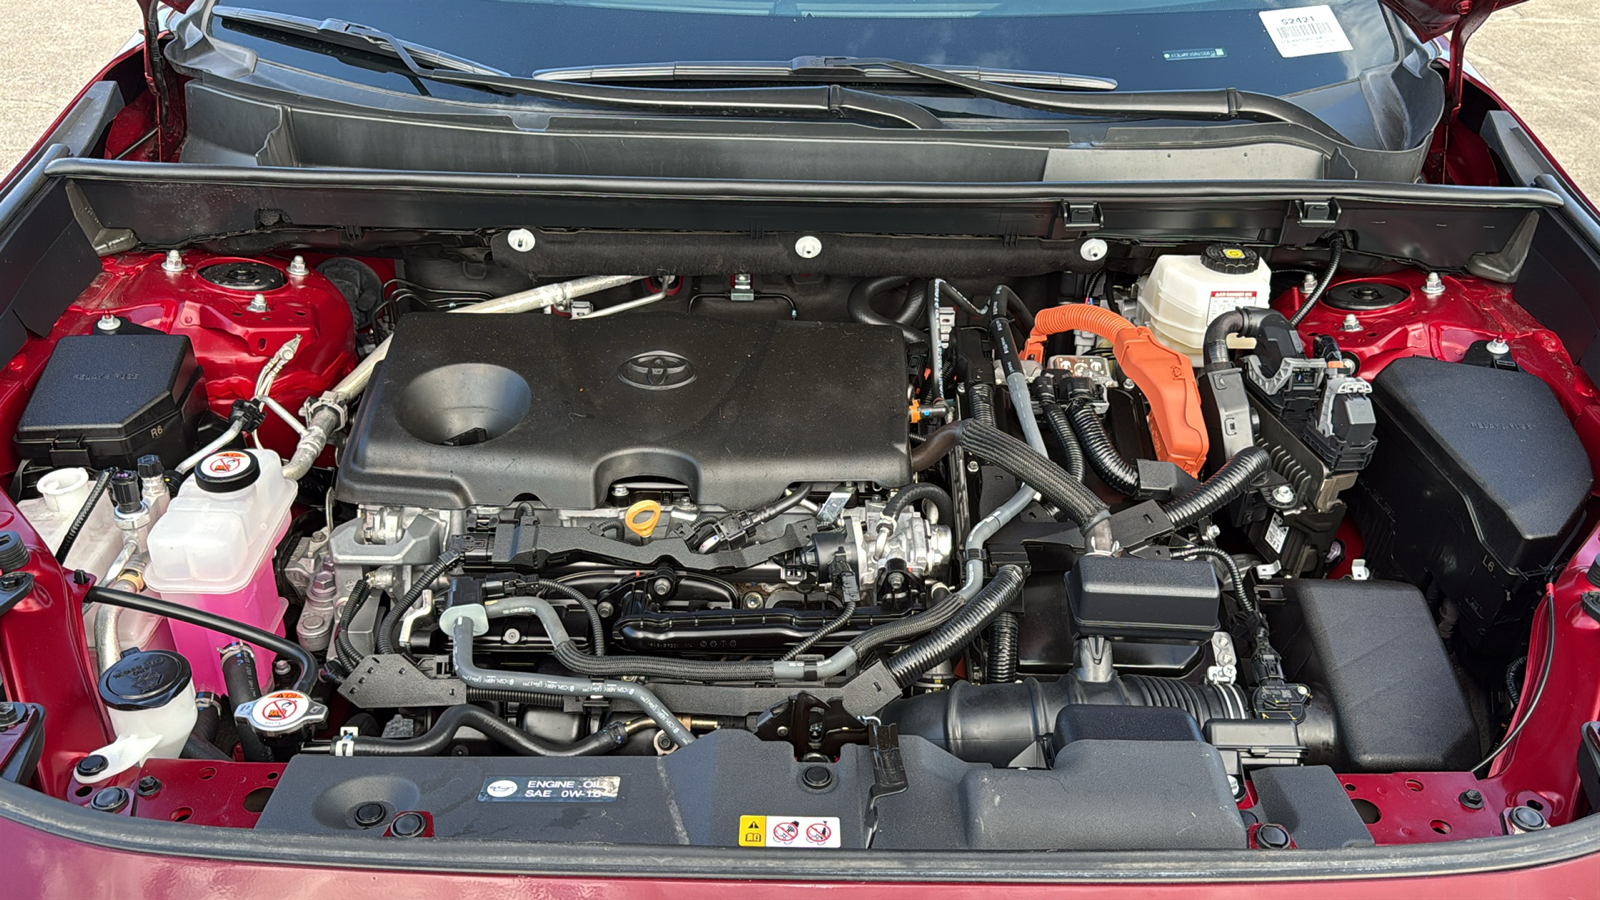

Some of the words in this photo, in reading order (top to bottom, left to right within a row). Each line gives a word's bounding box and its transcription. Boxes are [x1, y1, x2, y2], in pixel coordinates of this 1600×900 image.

[150, 425, 164, 439] R6
[1482, 554, 1495, 572] L6
[527, 780, 575, 788] ENGINE
[582, 780, 602, 788] OIL
[524, 790, 553, 798] SAE
